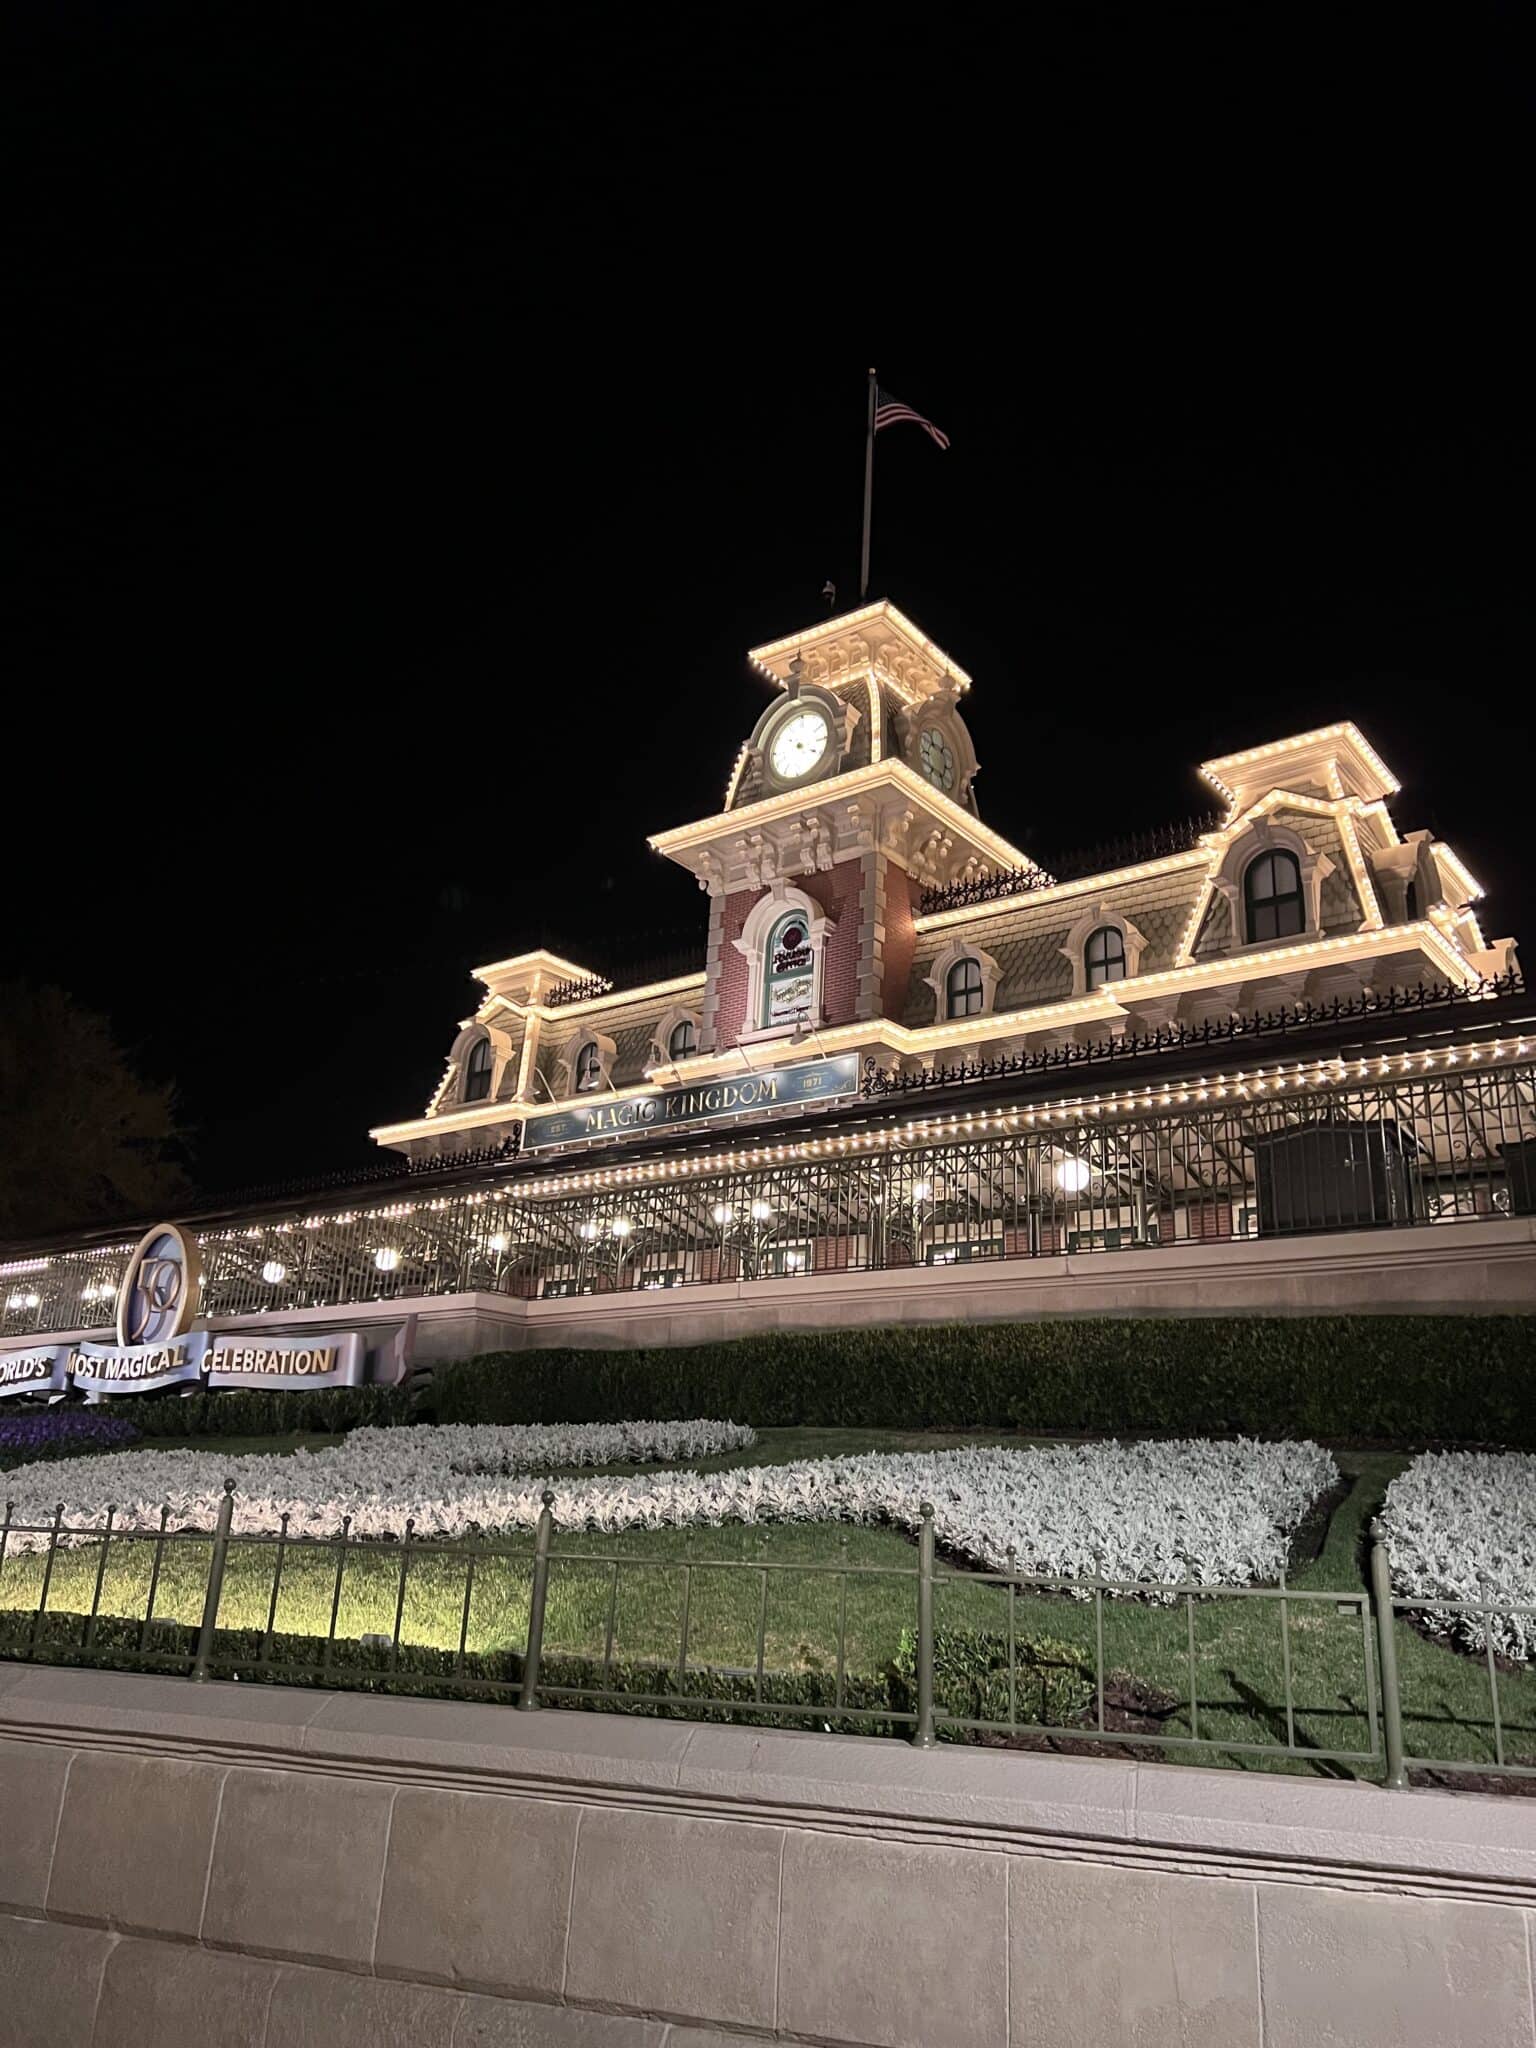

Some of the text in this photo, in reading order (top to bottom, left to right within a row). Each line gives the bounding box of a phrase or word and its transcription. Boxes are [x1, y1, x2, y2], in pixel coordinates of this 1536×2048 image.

[586, 1078, 778, 1132] MAGIC KINGDOM
[131, 1258, 181, 1339] 50
[64, 1350, 104, 1378] MOST
[105, 1345, 186, 1380] MAGICAL
[200, 1347, 336, 1375] CELEBRATION
